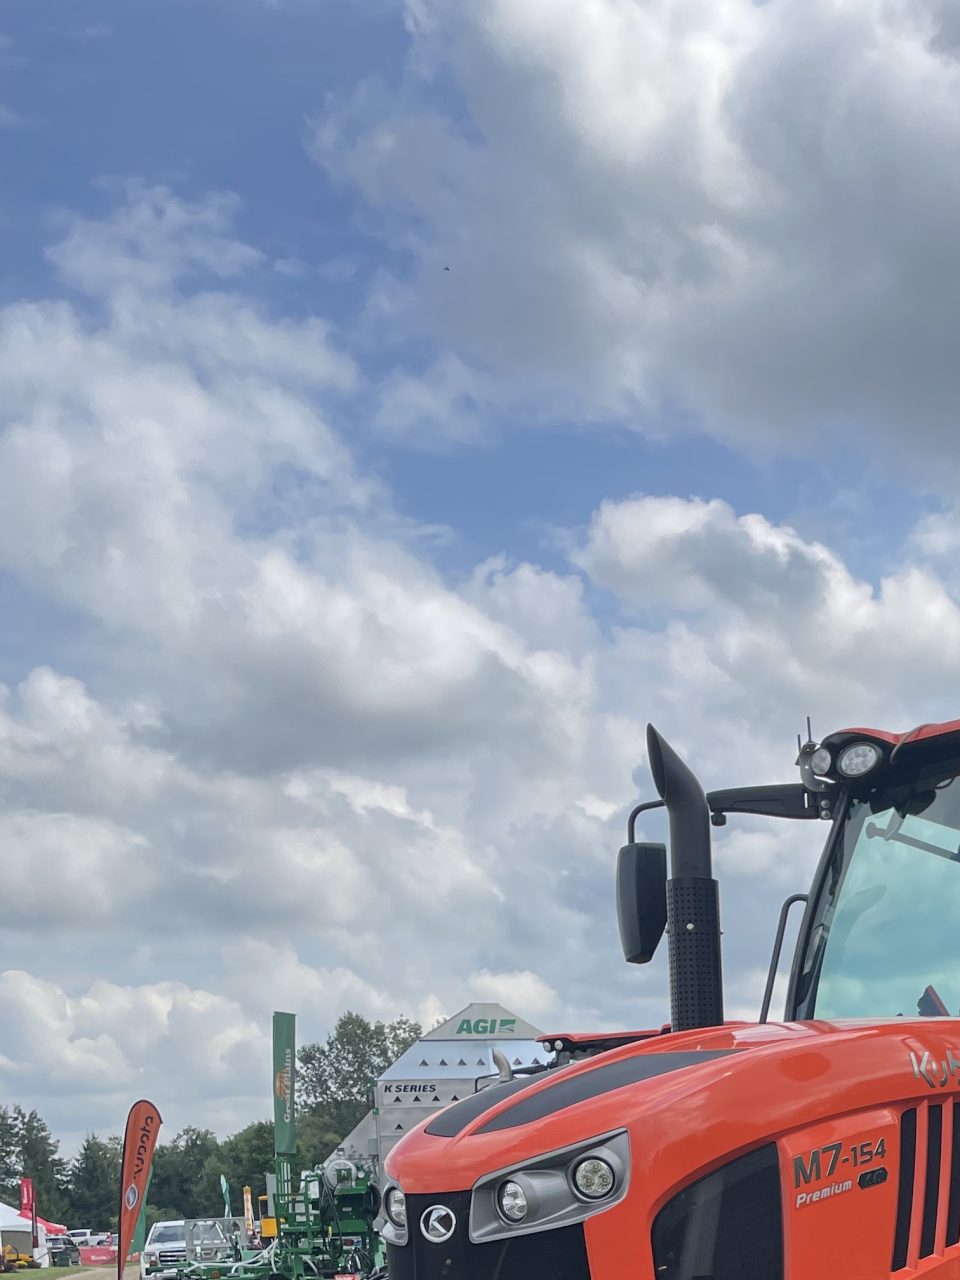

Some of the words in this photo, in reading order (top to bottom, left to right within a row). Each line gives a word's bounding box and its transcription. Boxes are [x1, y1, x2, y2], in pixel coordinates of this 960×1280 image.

[456, 1019, 497, 1035] AGI
[383, 1084, 393, 1093] K
[394, 1084, 437, 1093] SERIES
[133, 1115, 153, 1180] Kubota
[793, 1137, 886, 1189] M7-154
[796, 1180, 852, 1209] Premium
